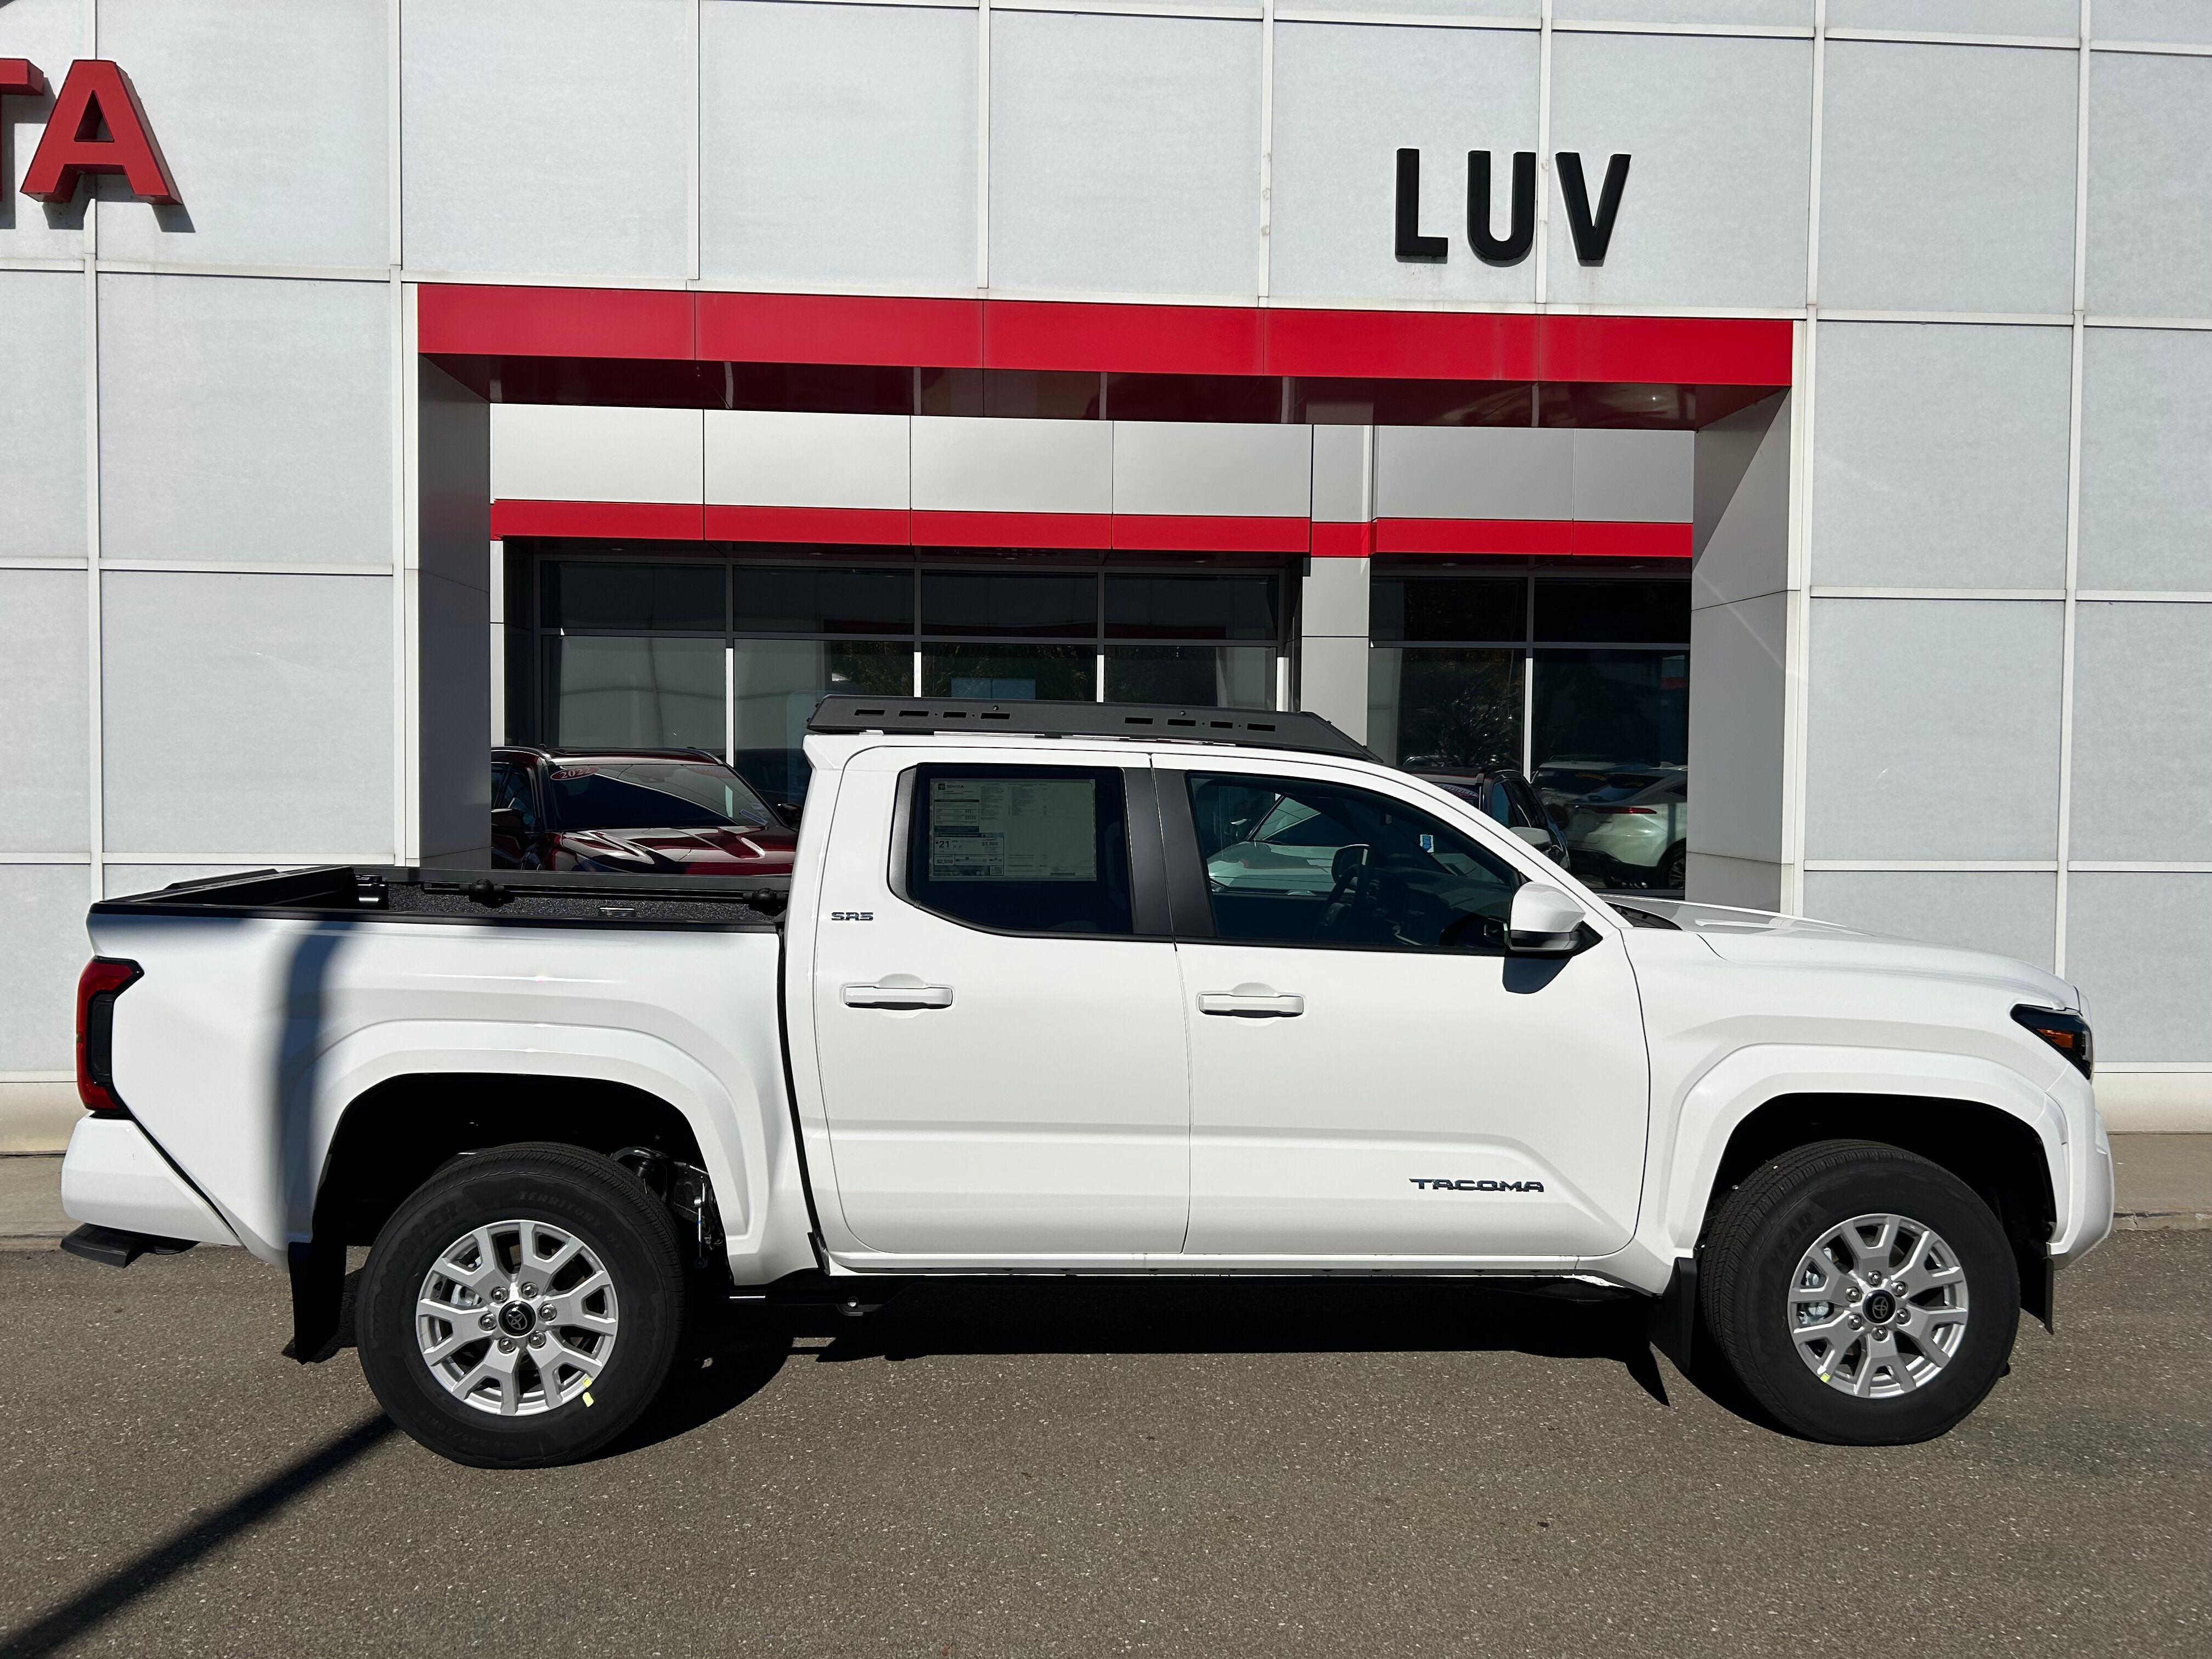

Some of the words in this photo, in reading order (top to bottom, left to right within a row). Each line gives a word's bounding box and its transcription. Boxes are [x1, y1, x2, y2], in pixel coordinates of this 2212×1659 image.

[1395, 148, 1631, 267] LUV
[560, 768, 590, 778] 2022
[831, 912, 873, 921] SR5
[1408, 1178, 1544, 1192] TACOMA
[519, 1192, 602, 1227] TERRITORY
